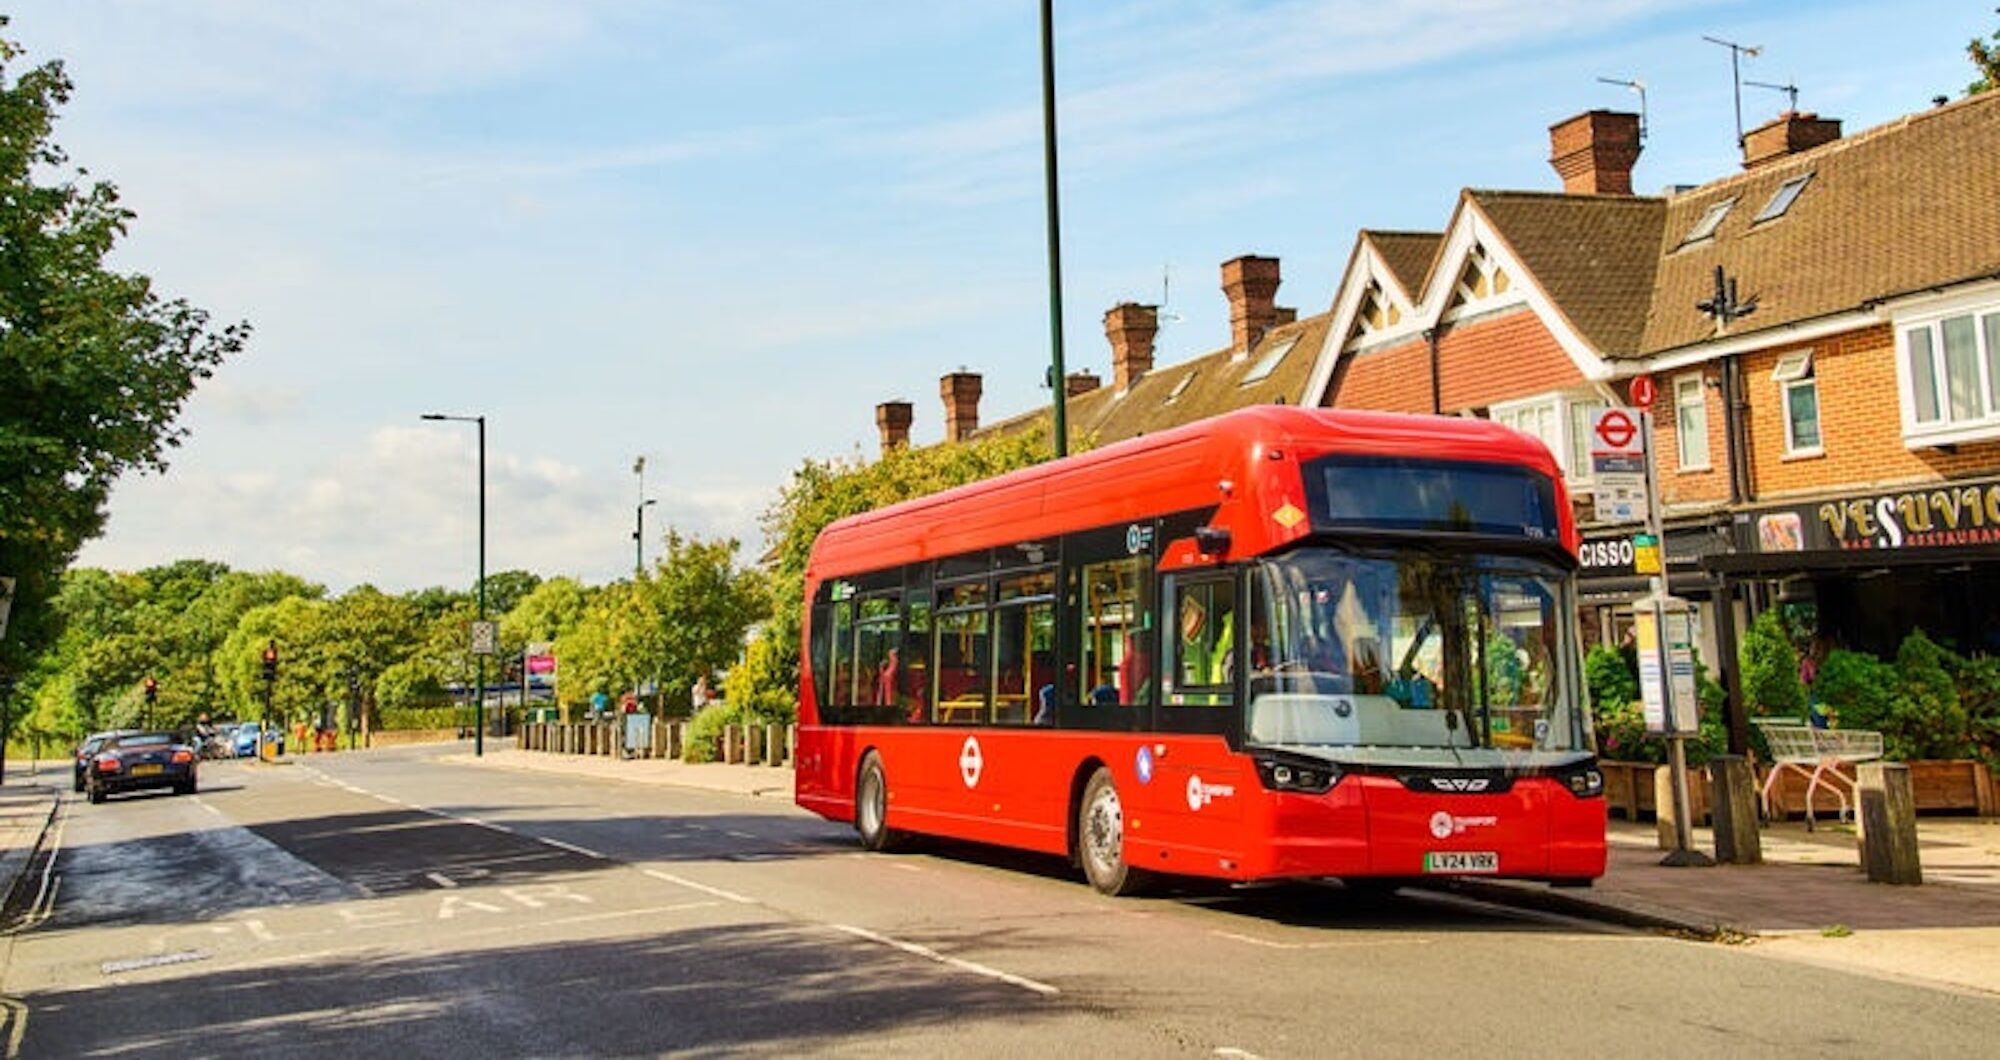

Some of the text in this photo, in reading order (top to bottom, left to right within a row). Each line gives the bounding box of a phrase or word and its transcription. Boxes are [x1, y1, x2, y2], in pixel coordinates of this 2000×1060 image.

[1639, 380, 1651, 404] J
[1579, 540, 1633, 566] CISSO
[1432, 855, 1466, 868] LV24
